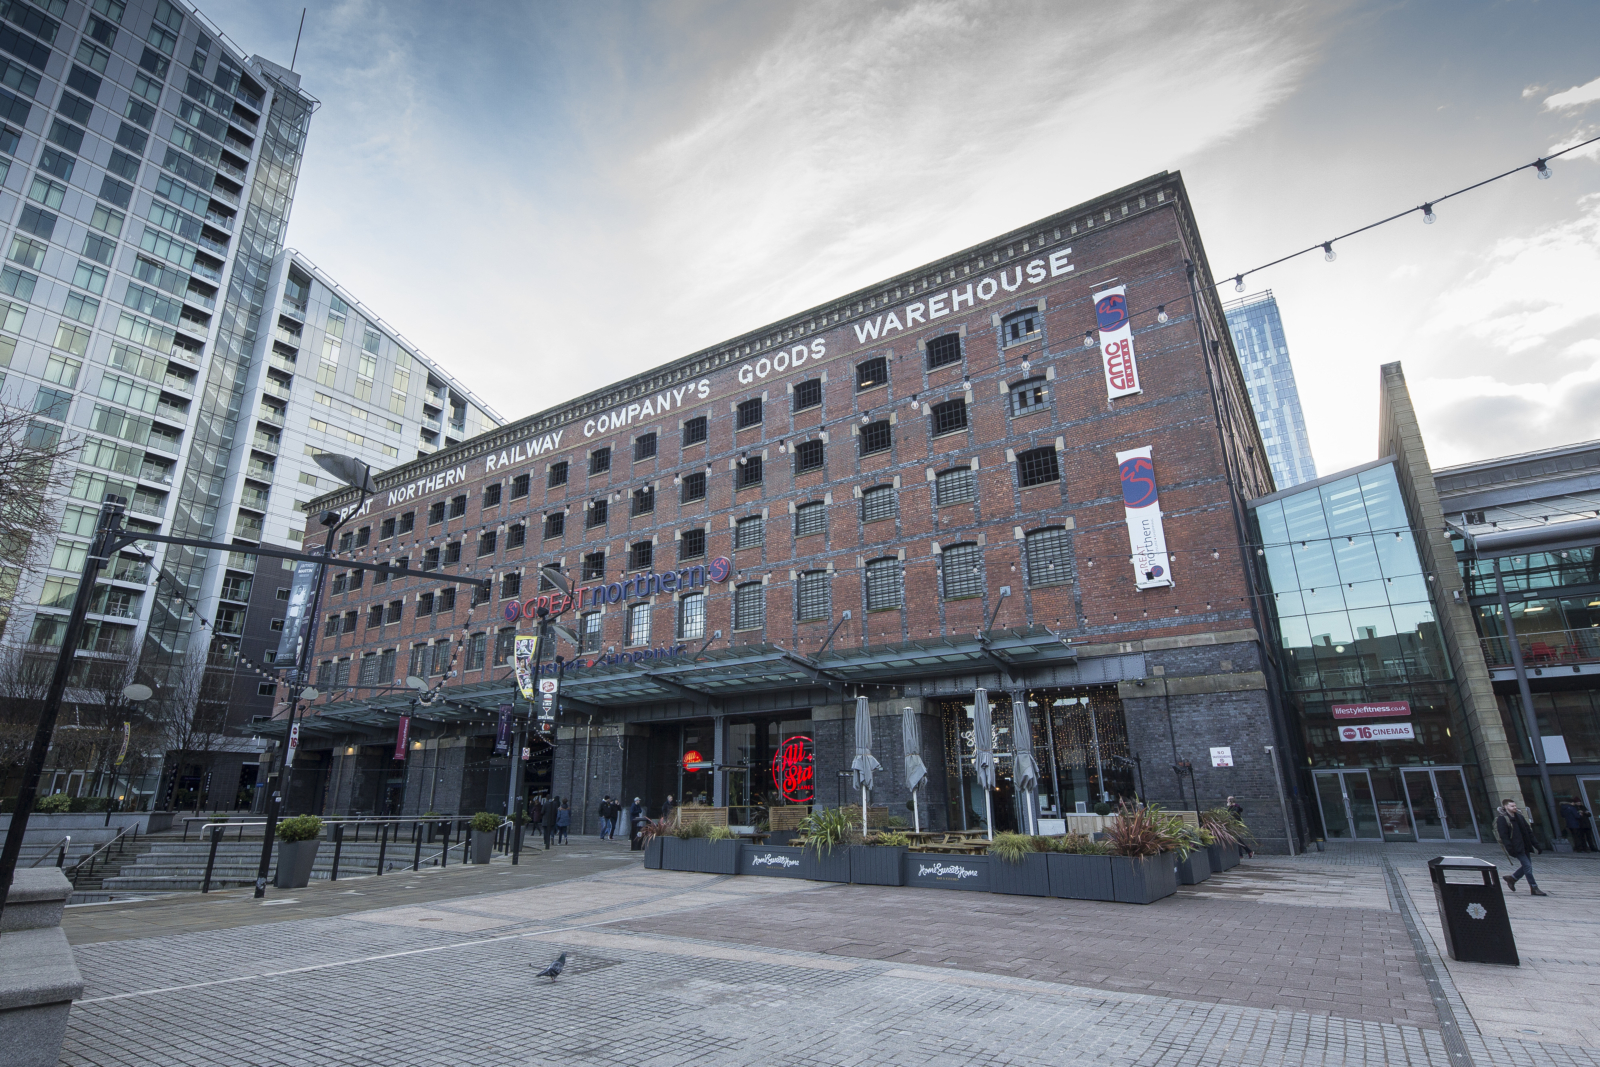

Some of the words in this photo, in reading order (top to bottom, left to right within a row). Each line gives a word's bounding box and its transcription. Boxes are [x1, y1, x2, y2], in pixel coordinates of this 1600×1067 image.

[1121, 340, 1134, 387] CINEMAS
[335, 498, 374, 524] REAT
[387, 465, 467, 507] NORTHERN
[485, 429, 564, 473] RAILWAY
[583, 378, 711, 438] COMPANY'S
[738, 337, 826, 385] GOODS
[853, 247, 1075, 344] WAREHOUSE
[1141, 519, 1156, 566] northern
[523, 587, 588, 618] GREAT
[591, 564, 706, 607] northern
[1334, 705, 1407, 715] lifestylefitness.co.uk
[1357, 727, 1372, 739] 16
[1372, 727, 1410, 736] CINEMAS
[777, 741, 807, 773] All
[783, 765, 814, 793] Sta
